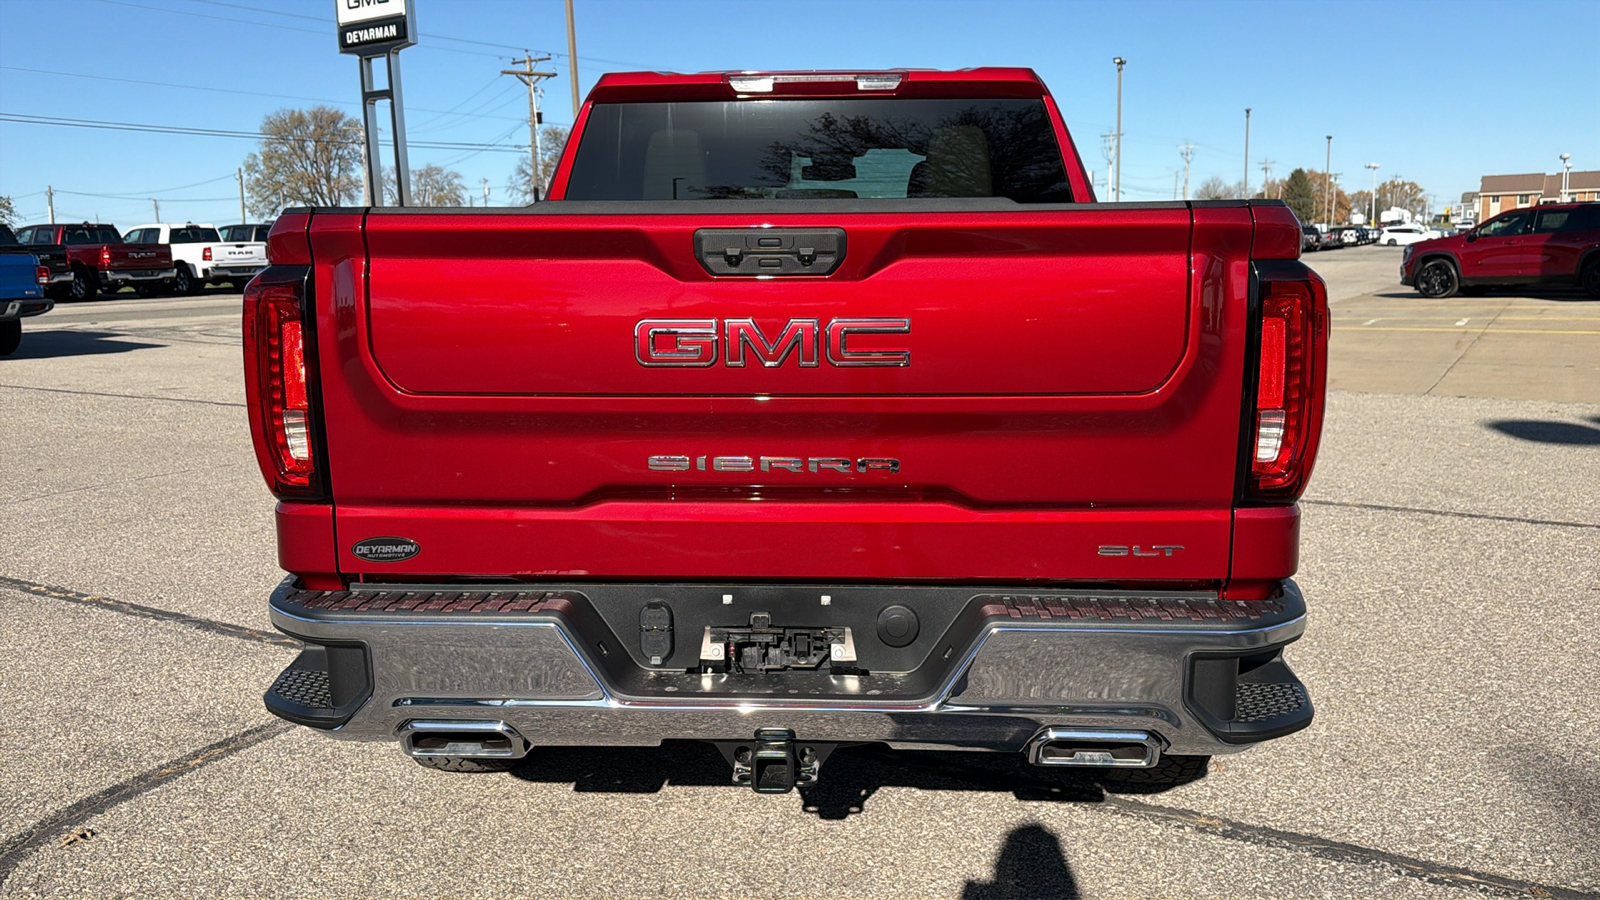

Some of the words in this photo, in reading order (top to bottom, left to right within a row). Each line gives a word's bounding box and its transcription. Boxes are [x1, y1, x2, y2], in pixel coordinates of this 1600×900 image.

[346, 24, 396, 44] DEYARMAN
[634, 317, 911, 368] GMC
[648, 455, 901, 473] SIERRA
[356, 545, 416, 554] DEYARMAN
[1098, 545, 1185, 556] SLT
